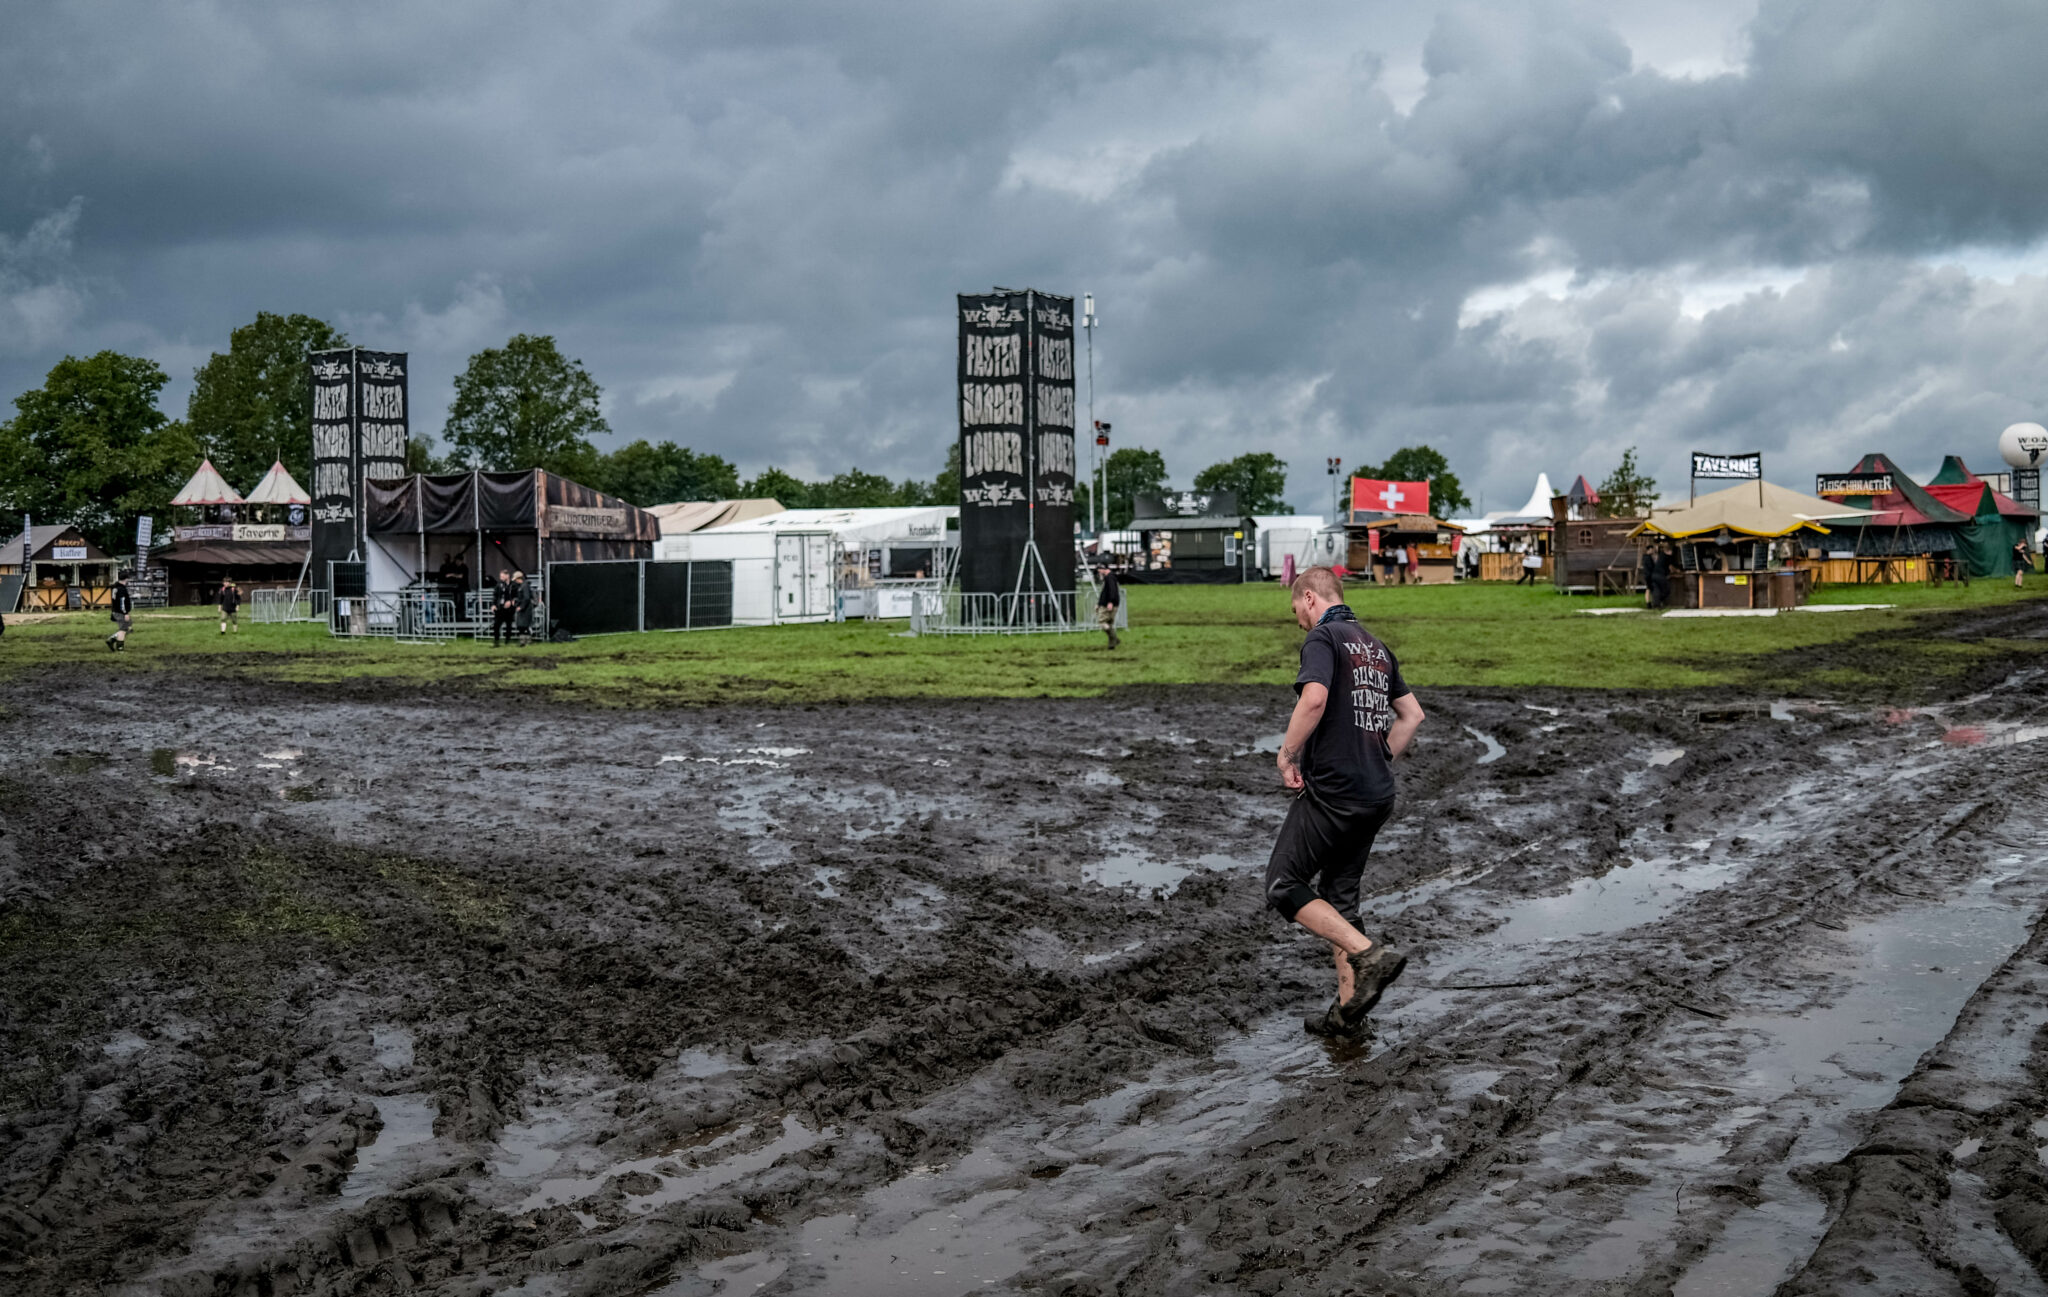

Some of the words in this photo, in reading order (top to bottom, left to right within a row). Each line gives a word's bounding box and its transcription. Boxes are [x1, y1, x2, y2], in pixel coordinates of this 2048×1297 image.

[966, 333, 1021, 378] FASTER
[1038, 333, 1072, 380] FASTER
[314, 382, 349, 420] FASTER
[362, 382, 403, 419] FASTER
[963, 382, 1023, 428] HARDER
[1037, 382, 1074, 429] HARDER
[312, 423, 350, 461] HARDER
[361, 421, 406, 458] HARDER
[965, 431, 1023, 478] LOUDER
[1038, 431, 1074, 478] LOUDER
[314, 462, 351, 500] LOUDER
[1693, 456, 1759, 473] TAVERNE
[239, 526, 280, 538] Taverne
